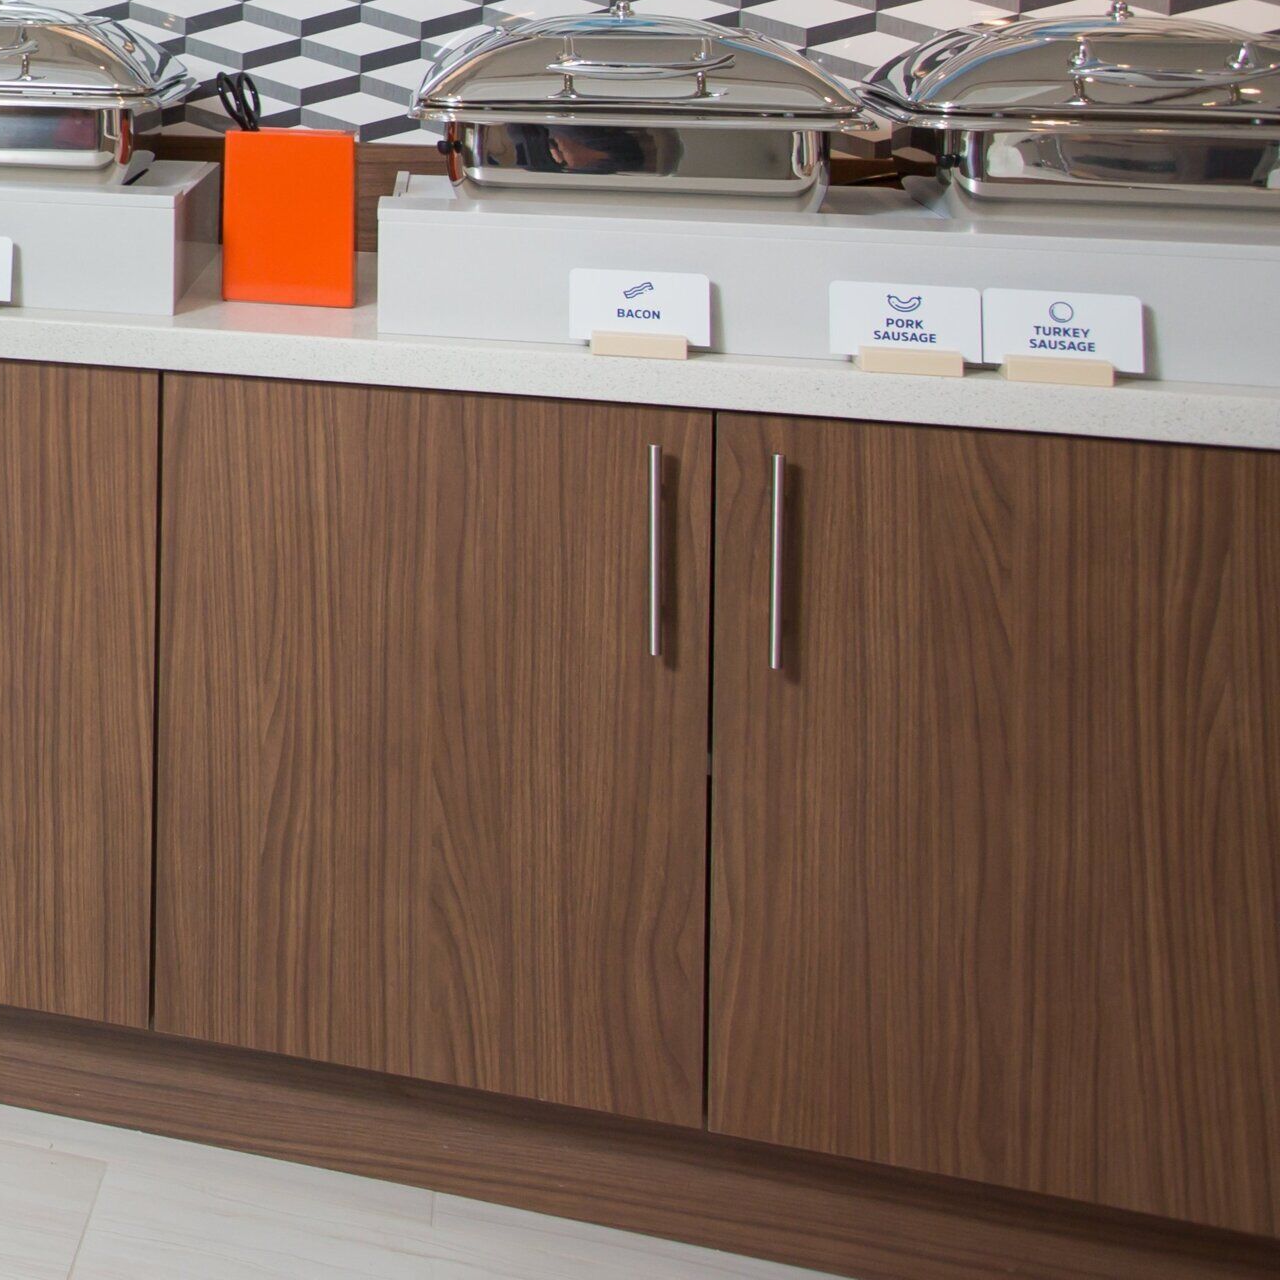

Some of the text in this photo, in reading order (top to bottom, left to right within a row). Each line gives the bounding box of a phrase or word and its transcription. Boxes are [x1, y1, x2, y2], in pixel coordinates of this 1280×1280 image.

[617, 308, 661, 320] BACON
[886, 317, 924, 330] PORK
[873, 330, 937, 344] SAUSAGE
[1033, 325, 1090, 338] TURKEY
[1029, 338, 1096, 353] SAUSAGE
